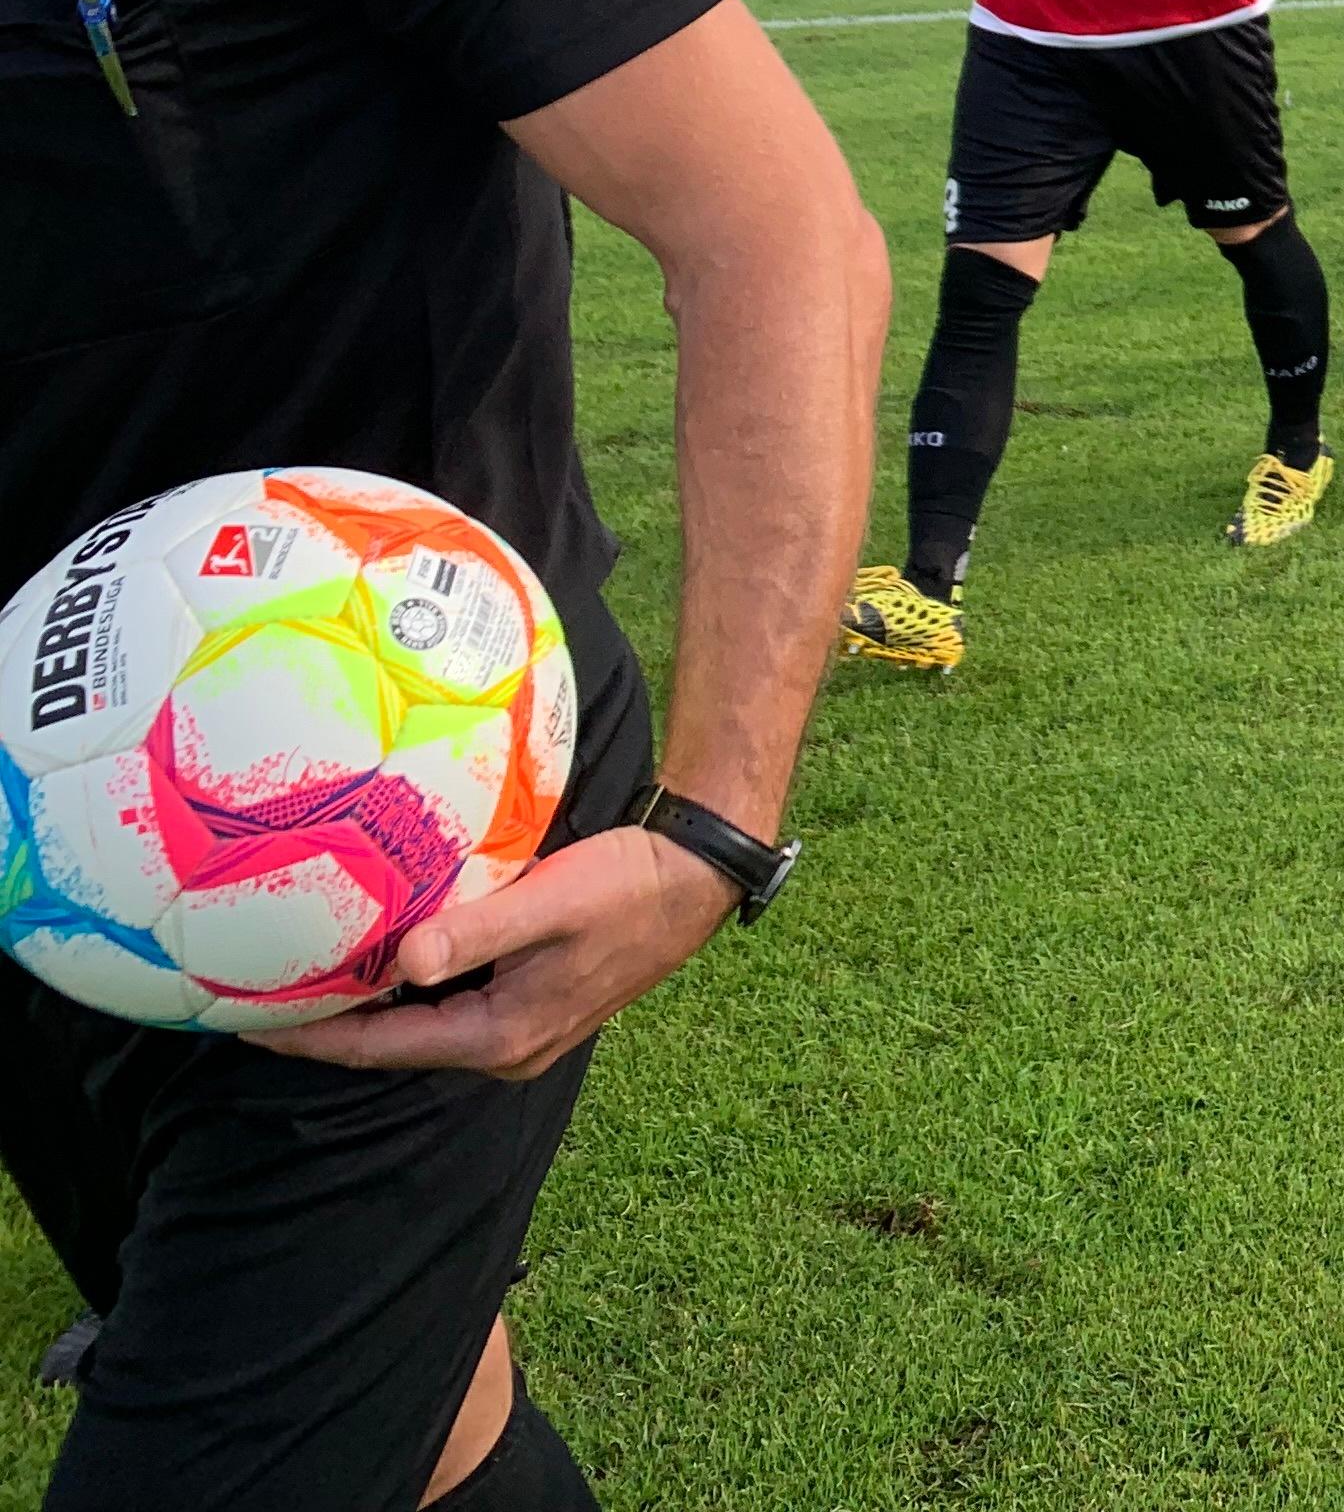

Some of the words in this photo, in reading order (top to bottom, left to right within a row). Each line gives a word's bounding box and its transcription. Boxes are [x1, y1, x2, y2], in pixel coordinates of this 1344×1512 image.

[1205, 197, 1250, 211] JAKO
[1265, 354, 1319, 378] JAKO
[92, 576, 127, 690] BUNDESLIGA
